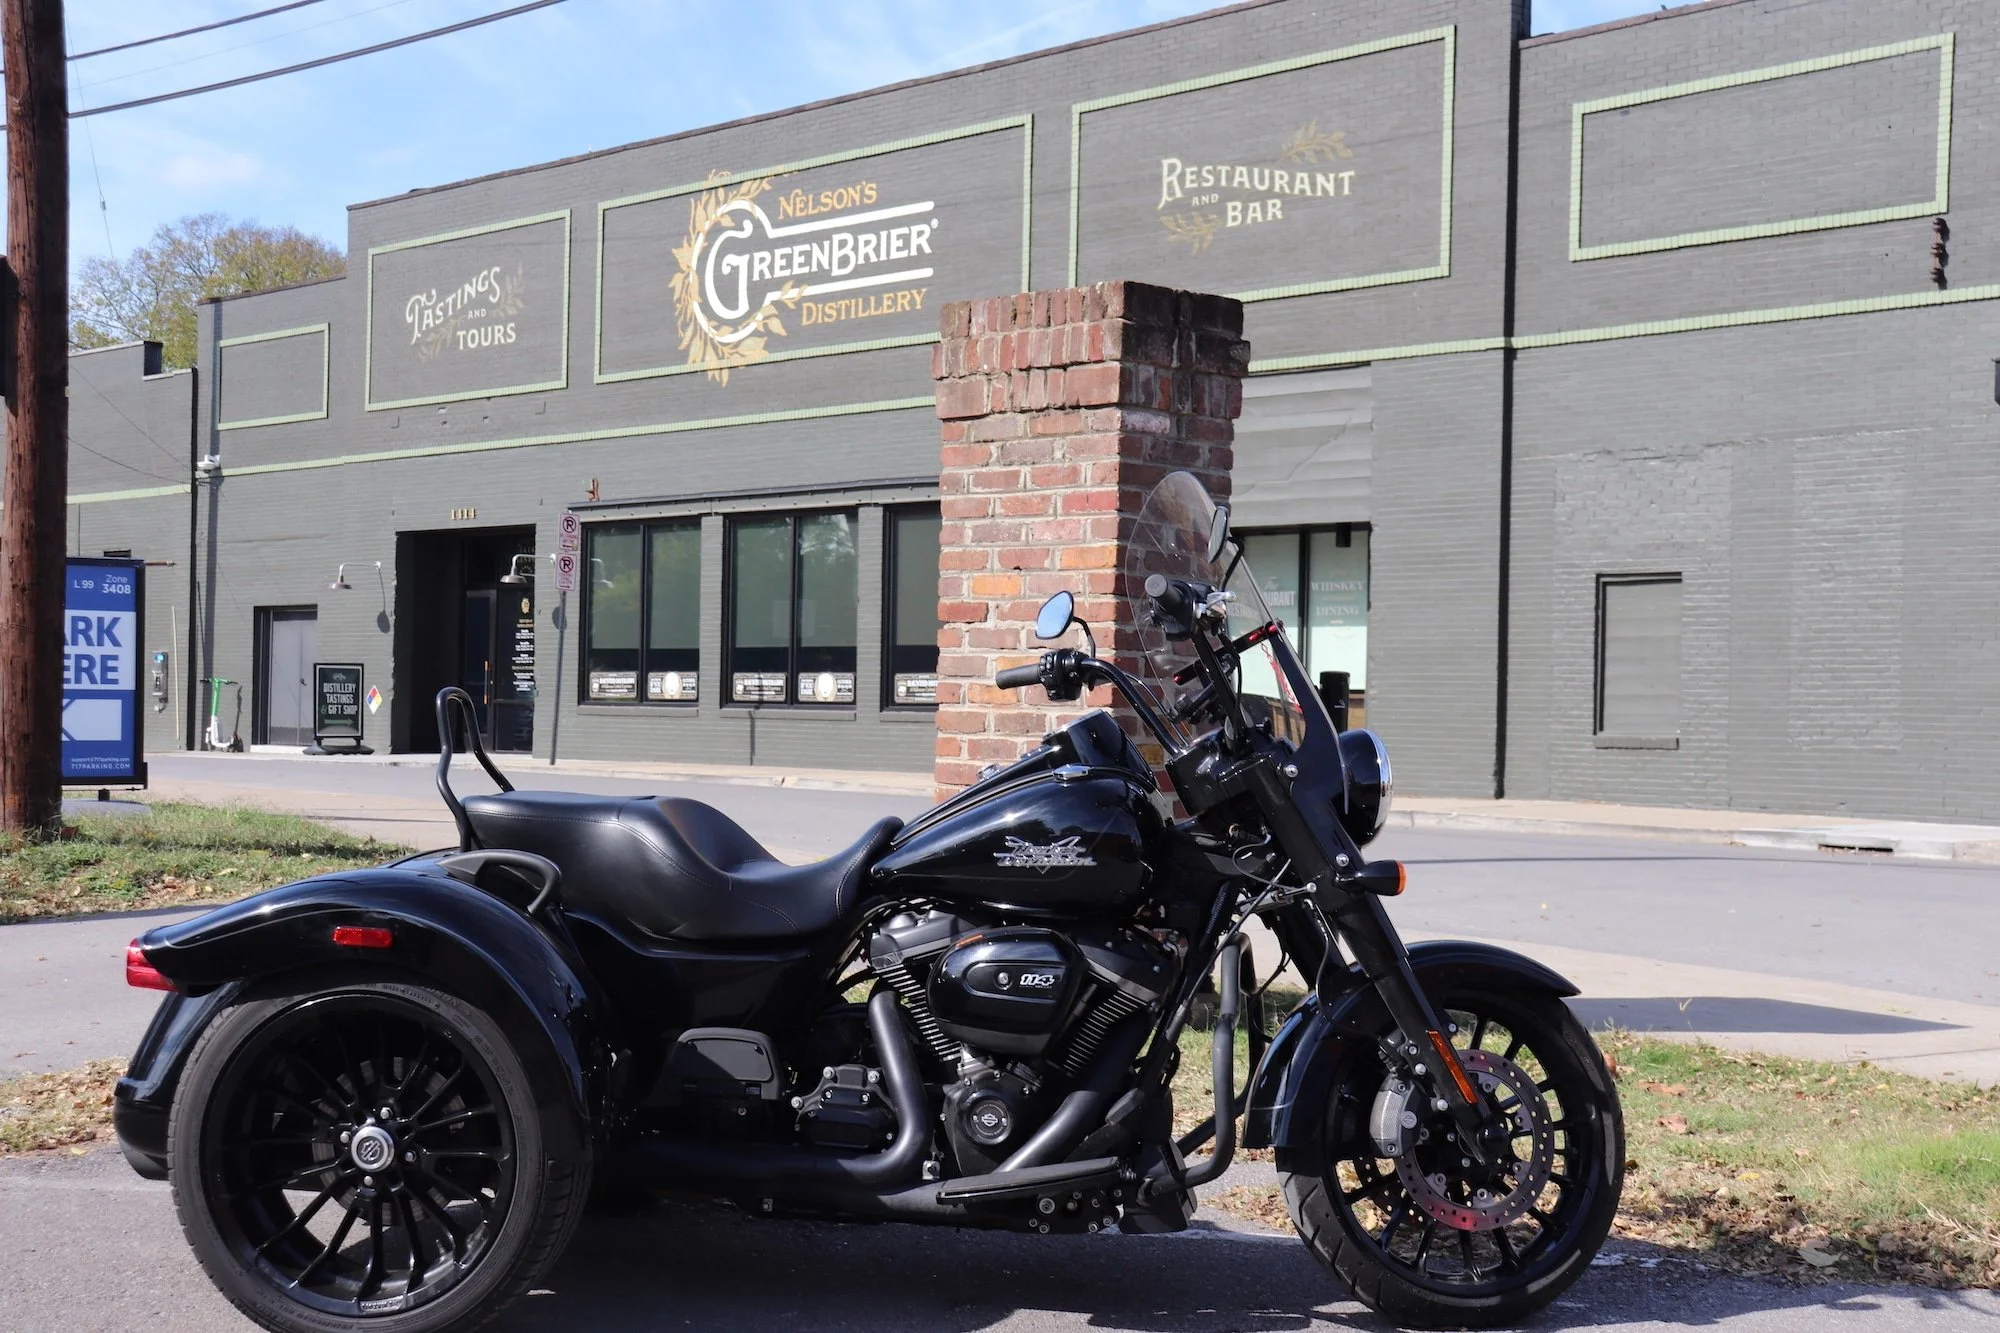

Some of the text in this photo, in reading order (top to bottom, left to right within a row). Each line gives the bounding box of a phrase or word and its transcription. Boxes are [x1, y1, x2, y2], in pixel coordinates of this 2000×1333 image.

[1157, 158, 1355, 210] RESTAURANT
[778, 181, 878, 220] NELSON'S
[1192, 194, 1219, 206] AND
[1226, 199, 1283, 227] BAR
[405, 266, 500, 345] TASTINGS
[802, 288, 927, 325] DISTILLERY
[468, 308, 486, 320] AND
[457, 323, 516, 350] TOURS
[74, 580, 94, 589] L 99
[106, 574, 128, 583] Zone
[102, 583, 131, 594] 3408
[1316, 605, 1359, 616] DINING
[64, 616, 122, 647] RK
[323, 682, 356, 693] DISTILLERY
[326, 693, 354, 704] TASTINGS
[328, 704, 342, 715] GIFT
[343, 704, 358, 715] SHOP
